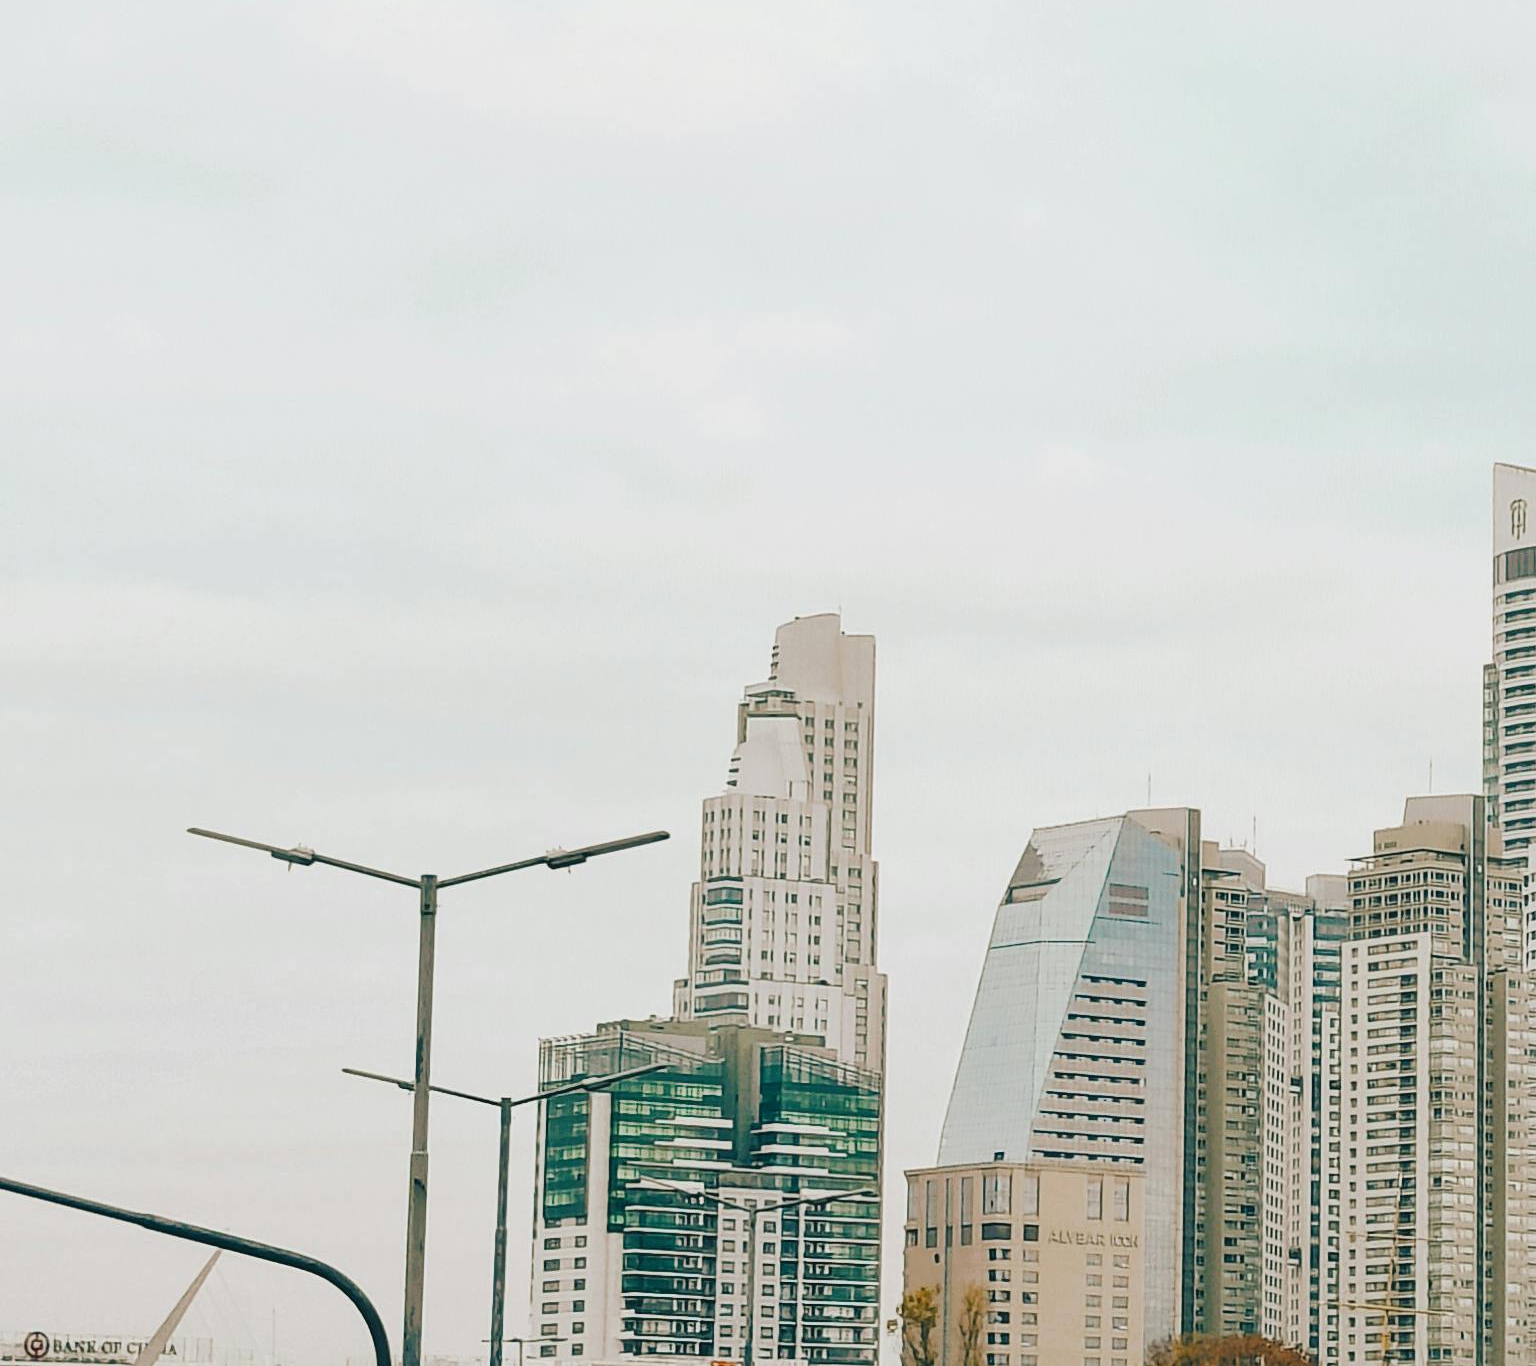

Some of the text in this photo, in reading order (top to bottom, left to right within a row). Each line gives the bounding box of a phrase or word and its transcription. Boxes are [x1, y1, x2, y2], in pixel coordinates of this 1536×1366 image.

[1047, 1230, 1105, 1247] ALVEAR
[53, 1338, 96, 1355] BANK
[101, 1341, 122, 1355] OF
